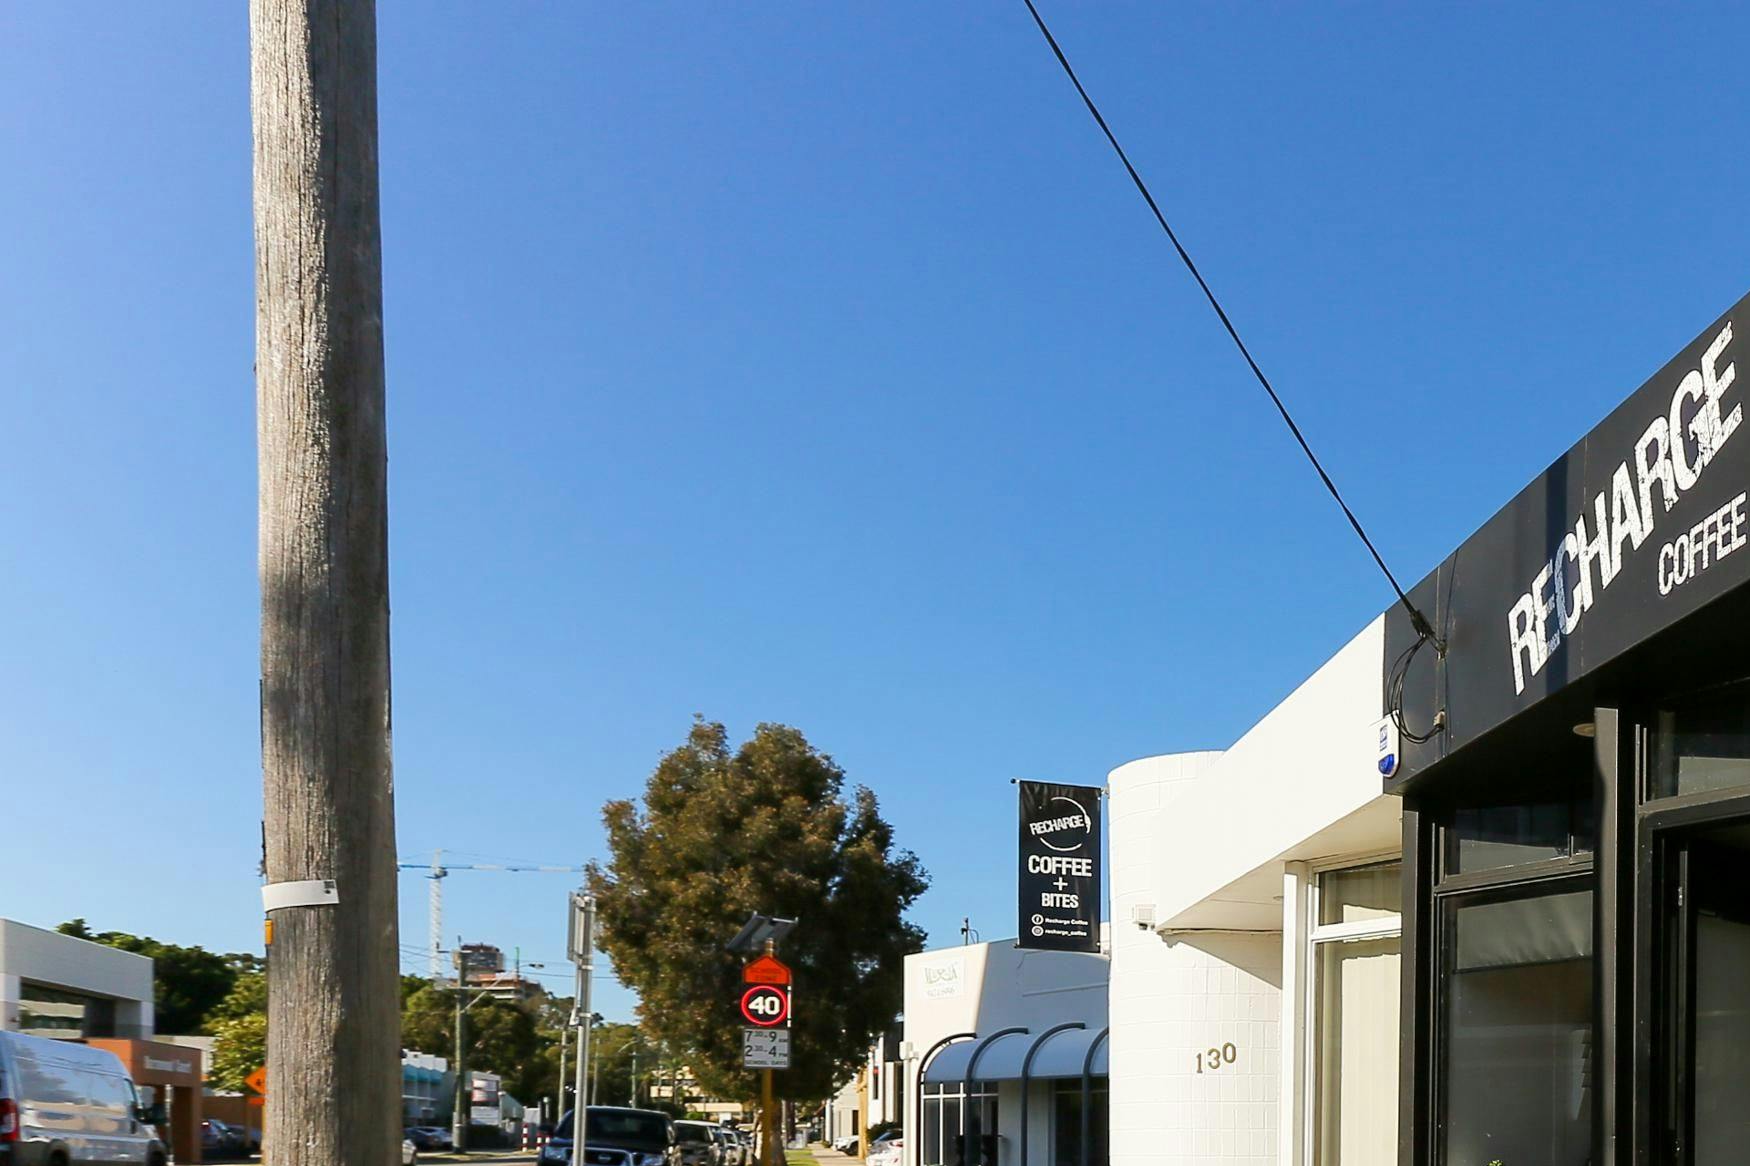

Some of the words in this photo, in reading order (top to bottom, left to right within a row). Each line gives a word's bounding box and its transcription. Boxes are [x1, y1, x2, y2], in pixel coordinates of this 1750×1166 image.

[1507, 320, 1743, 696] RECHARGE
[1658, 491, 1747, 596] COFFEE
[1029, 814, 1085, 836] RECHARGE
[1028, 854, 1093, 877] COFFEE
[1041, 892, 1079, 909] BITES
[748, 996, 780, 1015] 40
[1196, 1042, 1236, 1074] 130
